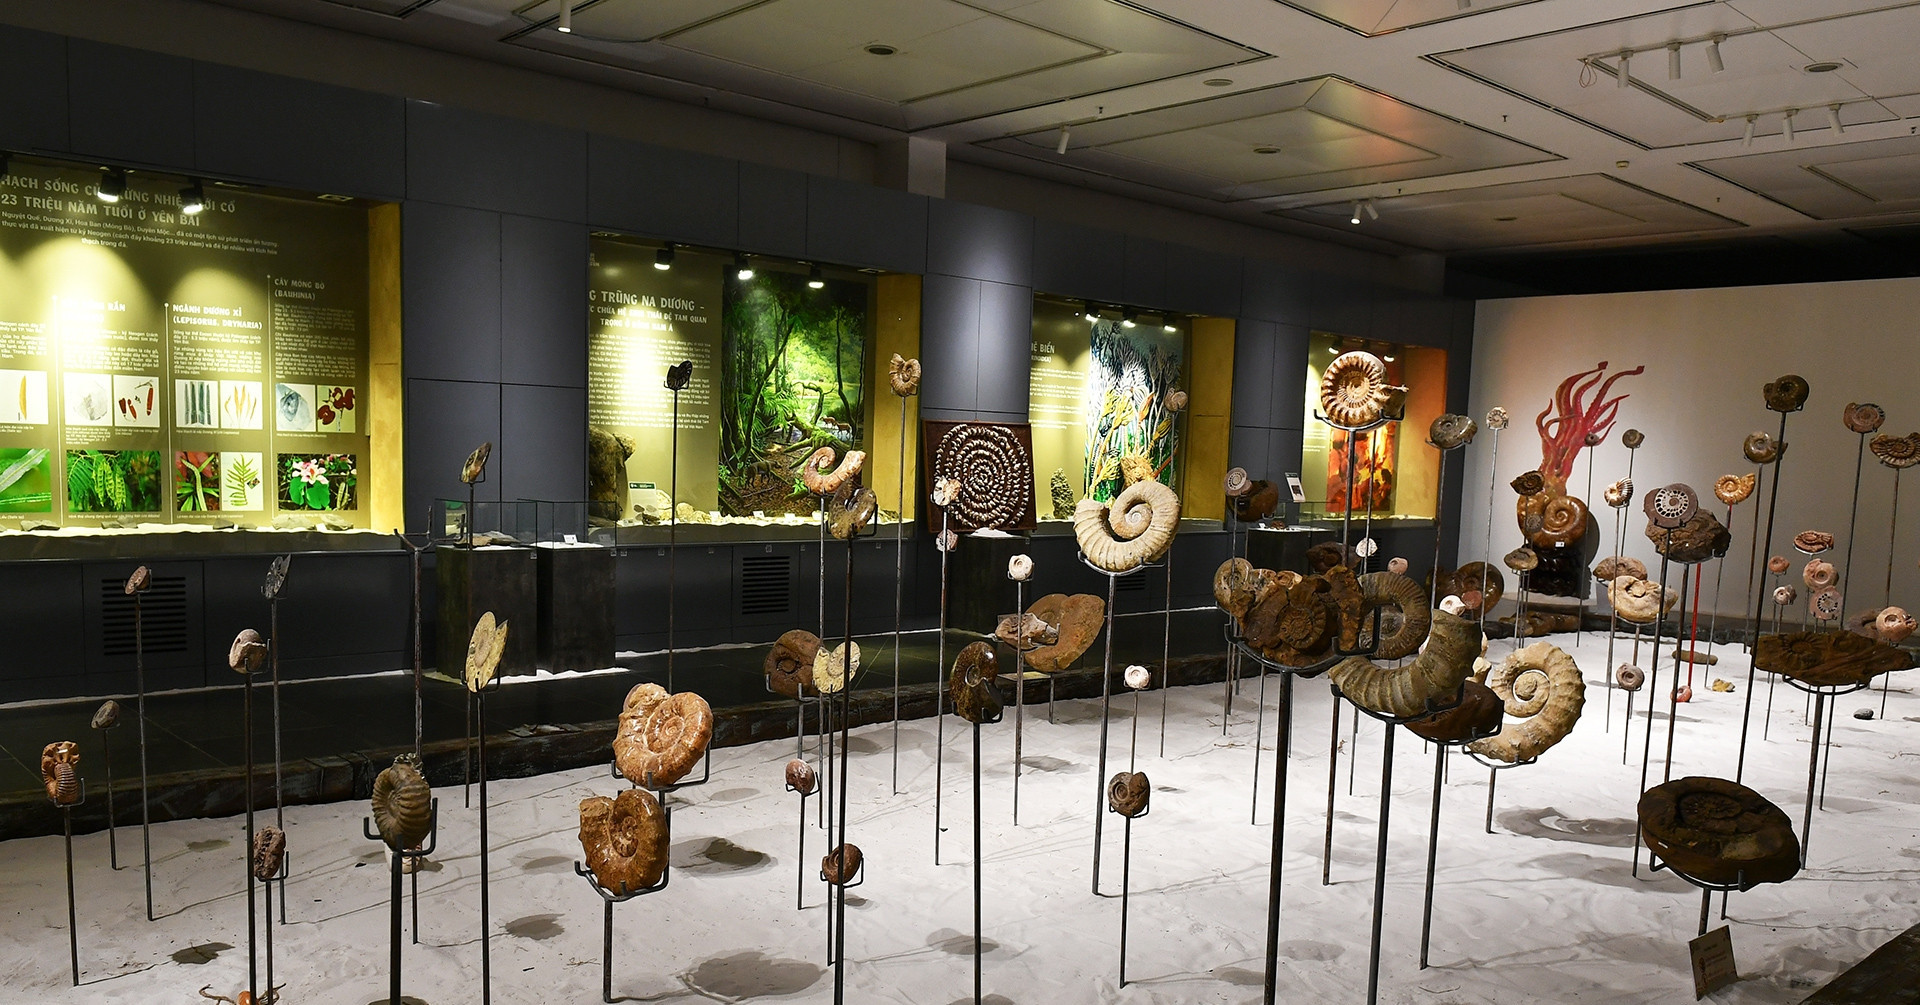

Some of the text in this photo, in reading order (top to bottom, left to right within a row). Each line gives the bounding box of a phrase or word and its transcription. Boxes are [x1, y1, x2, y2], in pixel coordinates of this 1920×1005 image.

[0, 174, 38, 189] HẠCH
[44, 177, 79, 194] SỐNG
[84, 182, 101, 197] CỦ
[119, 187, 149, 202] ỪNG
[154, 194, 183, 208] NHIỆ
[1, 194, 17, 206] 23
[23, 196, 63, 212] TRIỆU
[68, 200, 98, 215] NĂM
[103, 204, 133, 219] TUỔI
[138, 206, 147, 220] Ở
[152, 210, 174, 224] YÊN
[274, 289, 315, 301] (BAUHINIA)
[601, 290, 637, 305] TRŨNG
[641, 295, 656, 307] NA
[660, 297, 695, 311] DƯƠNG
[172, 303, 201, 314] NGÀNH
[674, 313, 688, 322] TAM
[689, 315, 708, 324] QUAN
